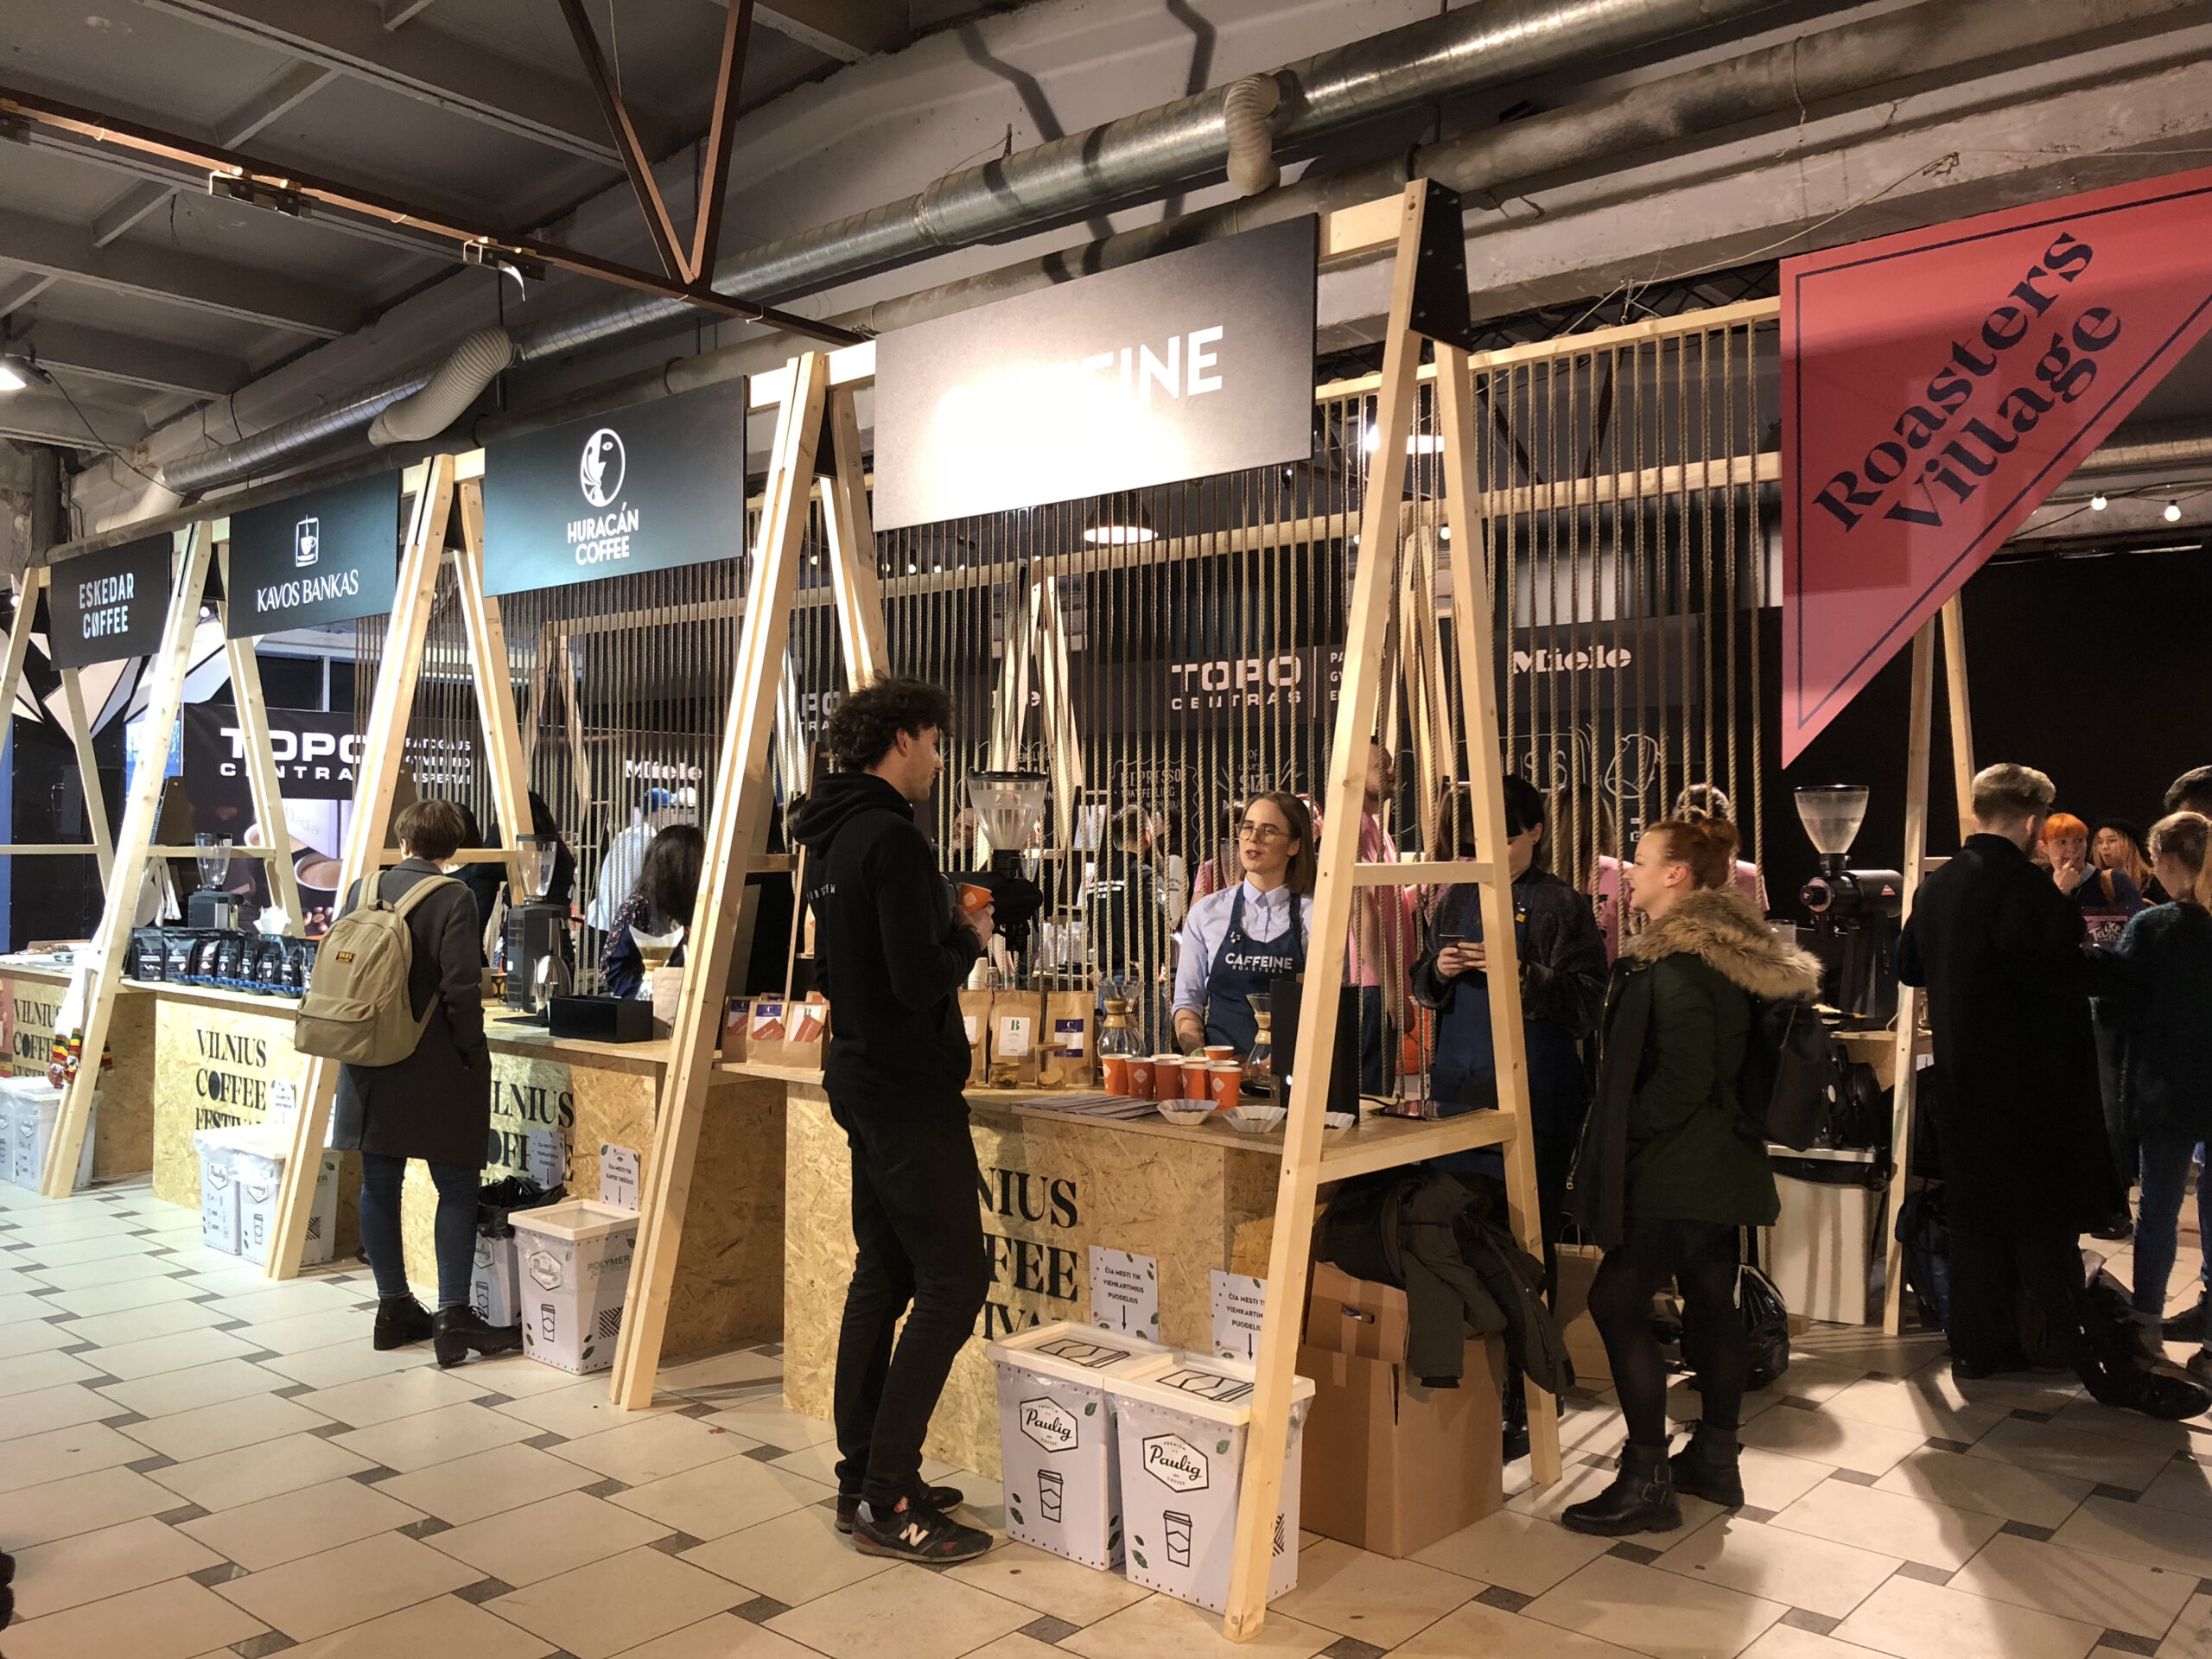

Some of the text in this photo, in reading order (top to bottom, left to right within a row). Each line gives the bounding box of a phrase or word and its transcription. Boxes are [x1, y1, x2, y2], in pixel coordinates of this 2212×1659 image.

[1814, 232, 2094, 533] Roasters
[1883, 306, 2121, 528] Village
[567, 501, 639, 544] HURACÁN
[575, 536, 630, 566] COFFEE
[79, 572, 134, 609] ESKEDAR
[257, 569, 359, 613] KAVOS BANKAS
[83, 605, 129, 639] COFFEE
[1172, 656, 1301, 692] TOPO
[1512, 645, 1632, 675] Miele
[1172, 690, 1301, 710] CENTRAS
[220, 727, 369, 765] TOPO
[220, 762, 355, 782] CNTRA
[625, 760, 702, 781] Miele
[1141, 785, 1175, 798] FELIG
[1224, 952, 1294, 969] CAFFEINE
[1010, 1019, 1020, 1031] B
[13, 1031, 55, 1062] COFF
[196, 1028, 266, 1068] VILNIUS
[195, 1068, 266, 1111] COFFEE
[491, 1080, 575, 1128] LNIUS
[195, 1107, 262, 1130] FESTI
[977, 1166, 1077, 1229] NIUS
[982, 1232, 1077, 1302] FEE
[1104, 1266, 1115, 1274] ČIA
[1116, 1270, 1131, 1279] MESTI
[1103, 1279, 1144, 1294] VIENKARTINIUS
[1108, 1292, 1139, 1305] PUODELIUS
[1228, 1292, 1239, 1301] ČIA
[1240, 1296, 1259, 1305] MESTI
[1226, 1306, 1263, 1319] VIENKARTIN
[1231, 1319, 1262, 1332] PUODELI
[1026, 1407, 1072, 1442] Paulig
[1149, 1444, 1203, 1481] Paulig
